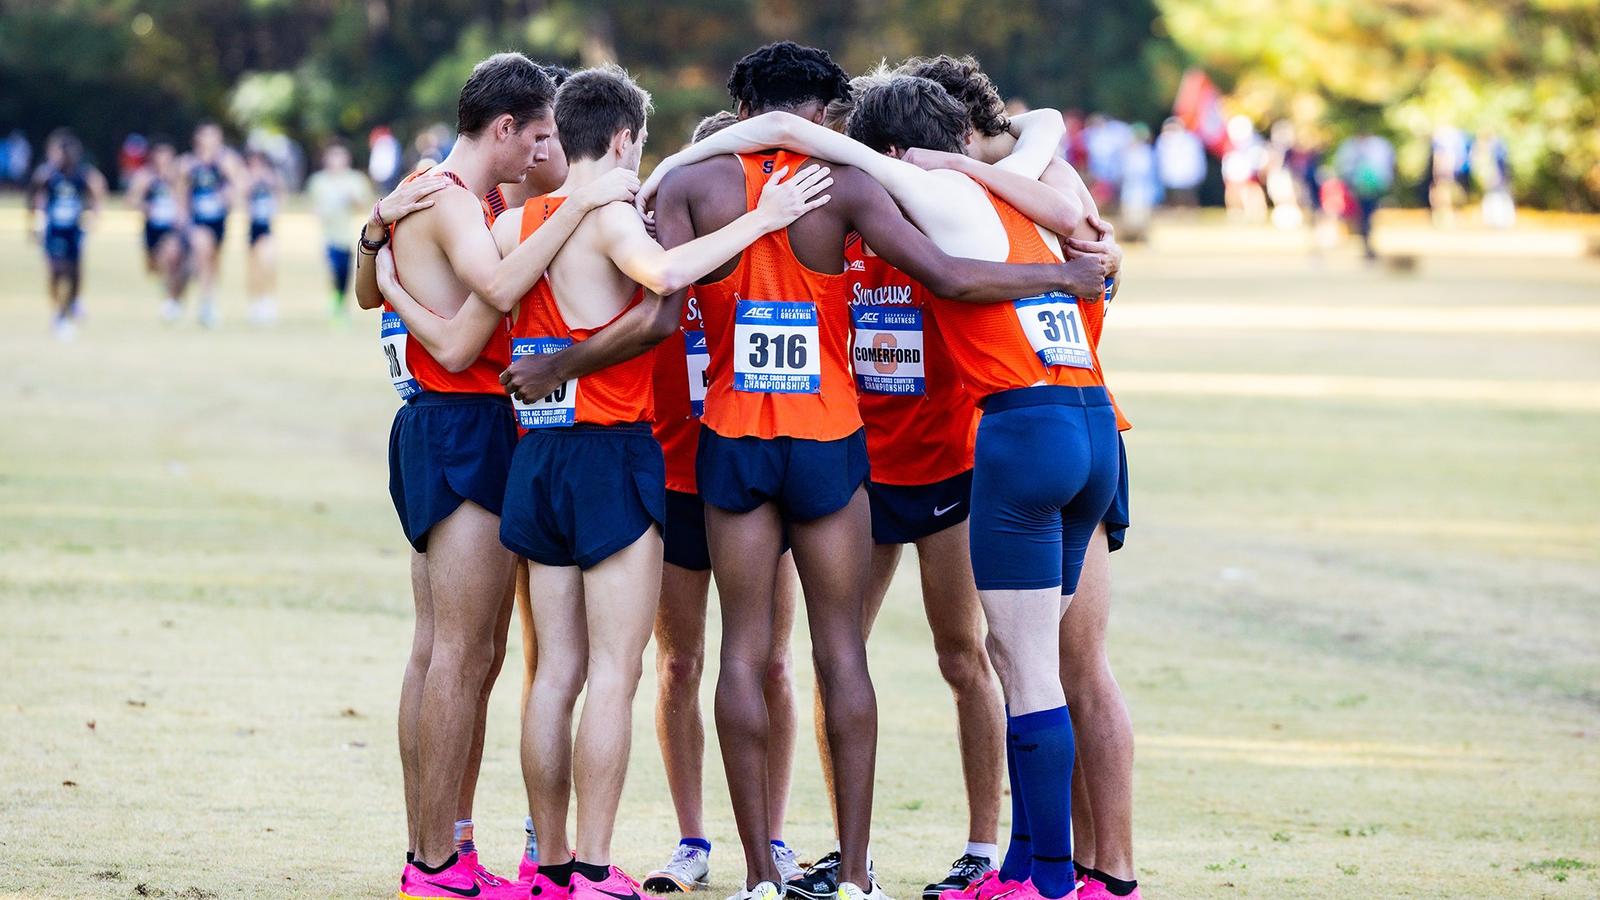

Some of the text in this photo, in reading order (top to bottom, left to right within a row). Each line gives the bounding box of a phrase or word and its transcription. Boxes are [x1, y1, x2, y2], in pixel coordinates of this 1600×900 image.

[743, 307, 774, 318] ACC
[780, 312, 812, 320] GREATNESS
[858, 312, 879, 322] ACC
[1037, 310, 1080, 343] 311
[512, 344, 536, 355] ACC
[749, 332, 807, 369] 316
[855, 347, 920, 363] COMERFORD
[743, 380, 810, 390] CHAMPIONSHIPS
[864, 382, 915, 393] CHAMPIONSHIPS
[521, 415, 567, 425] CHAMPIONSHIPS
